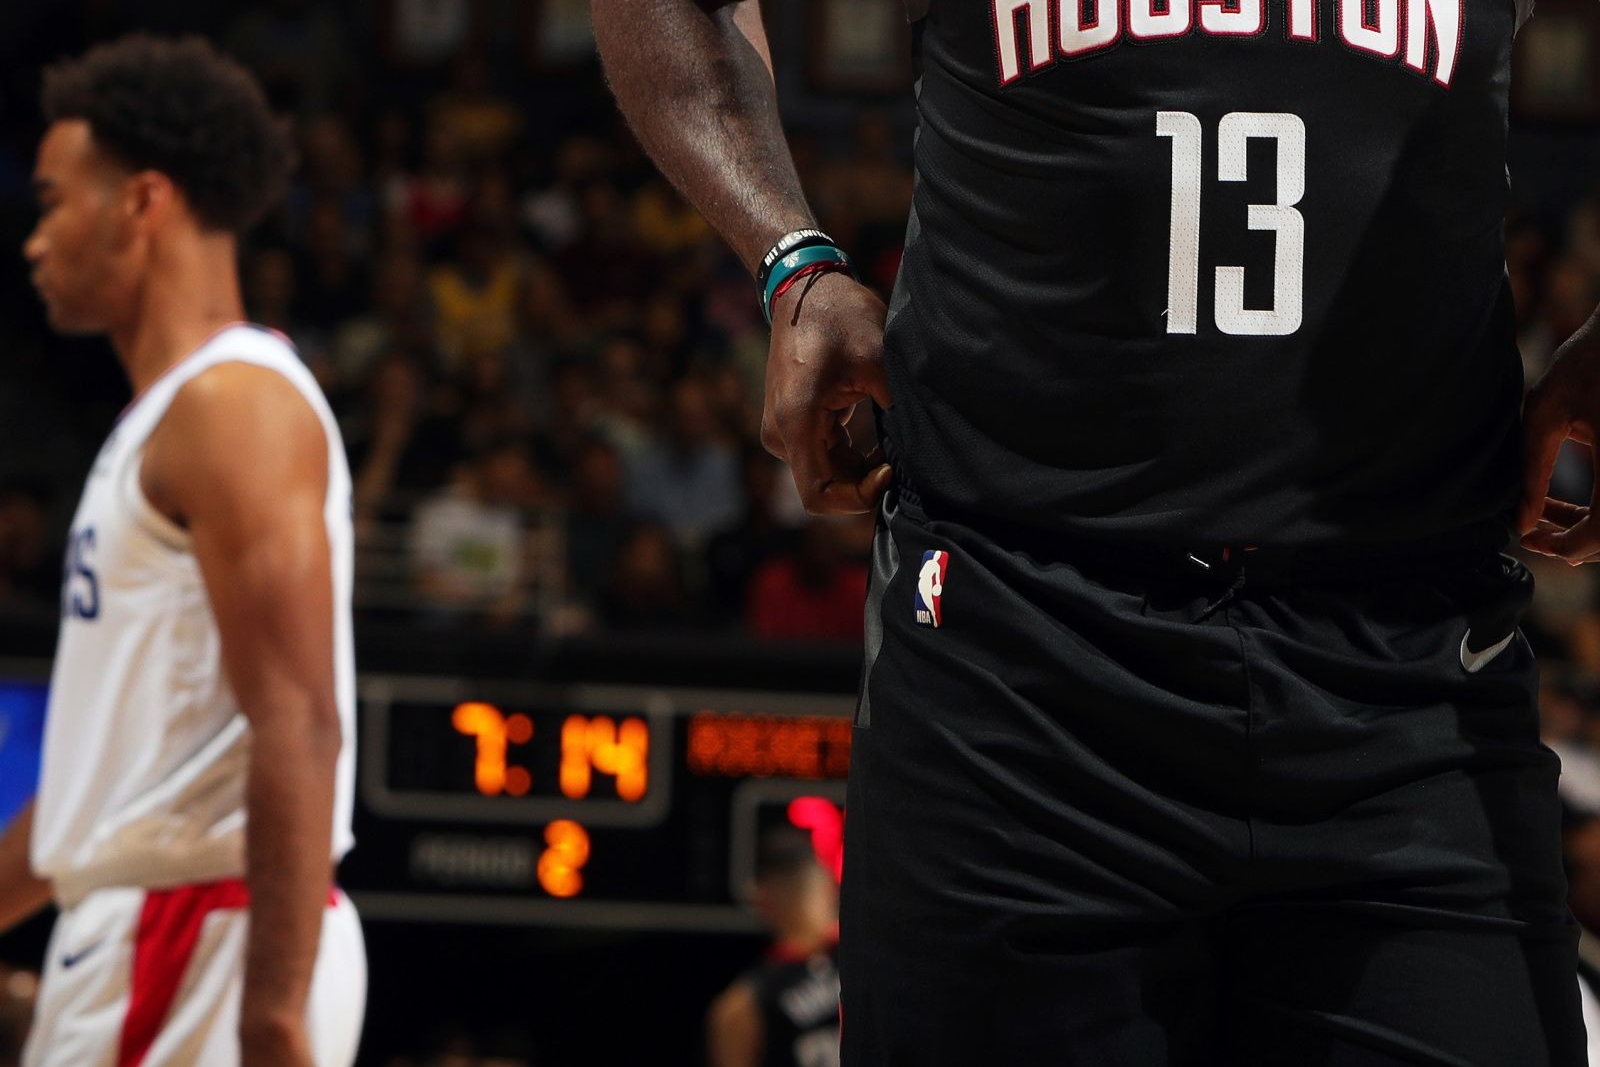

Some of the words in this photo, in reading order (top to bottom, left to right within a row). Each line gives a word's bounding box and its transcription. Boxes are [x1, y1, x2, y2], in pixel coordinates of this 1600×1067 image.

[1155, 110, 1306, 336] 13
[916, 609, 932, 624] NBA
[452, 702, 648, 802] 7:14
